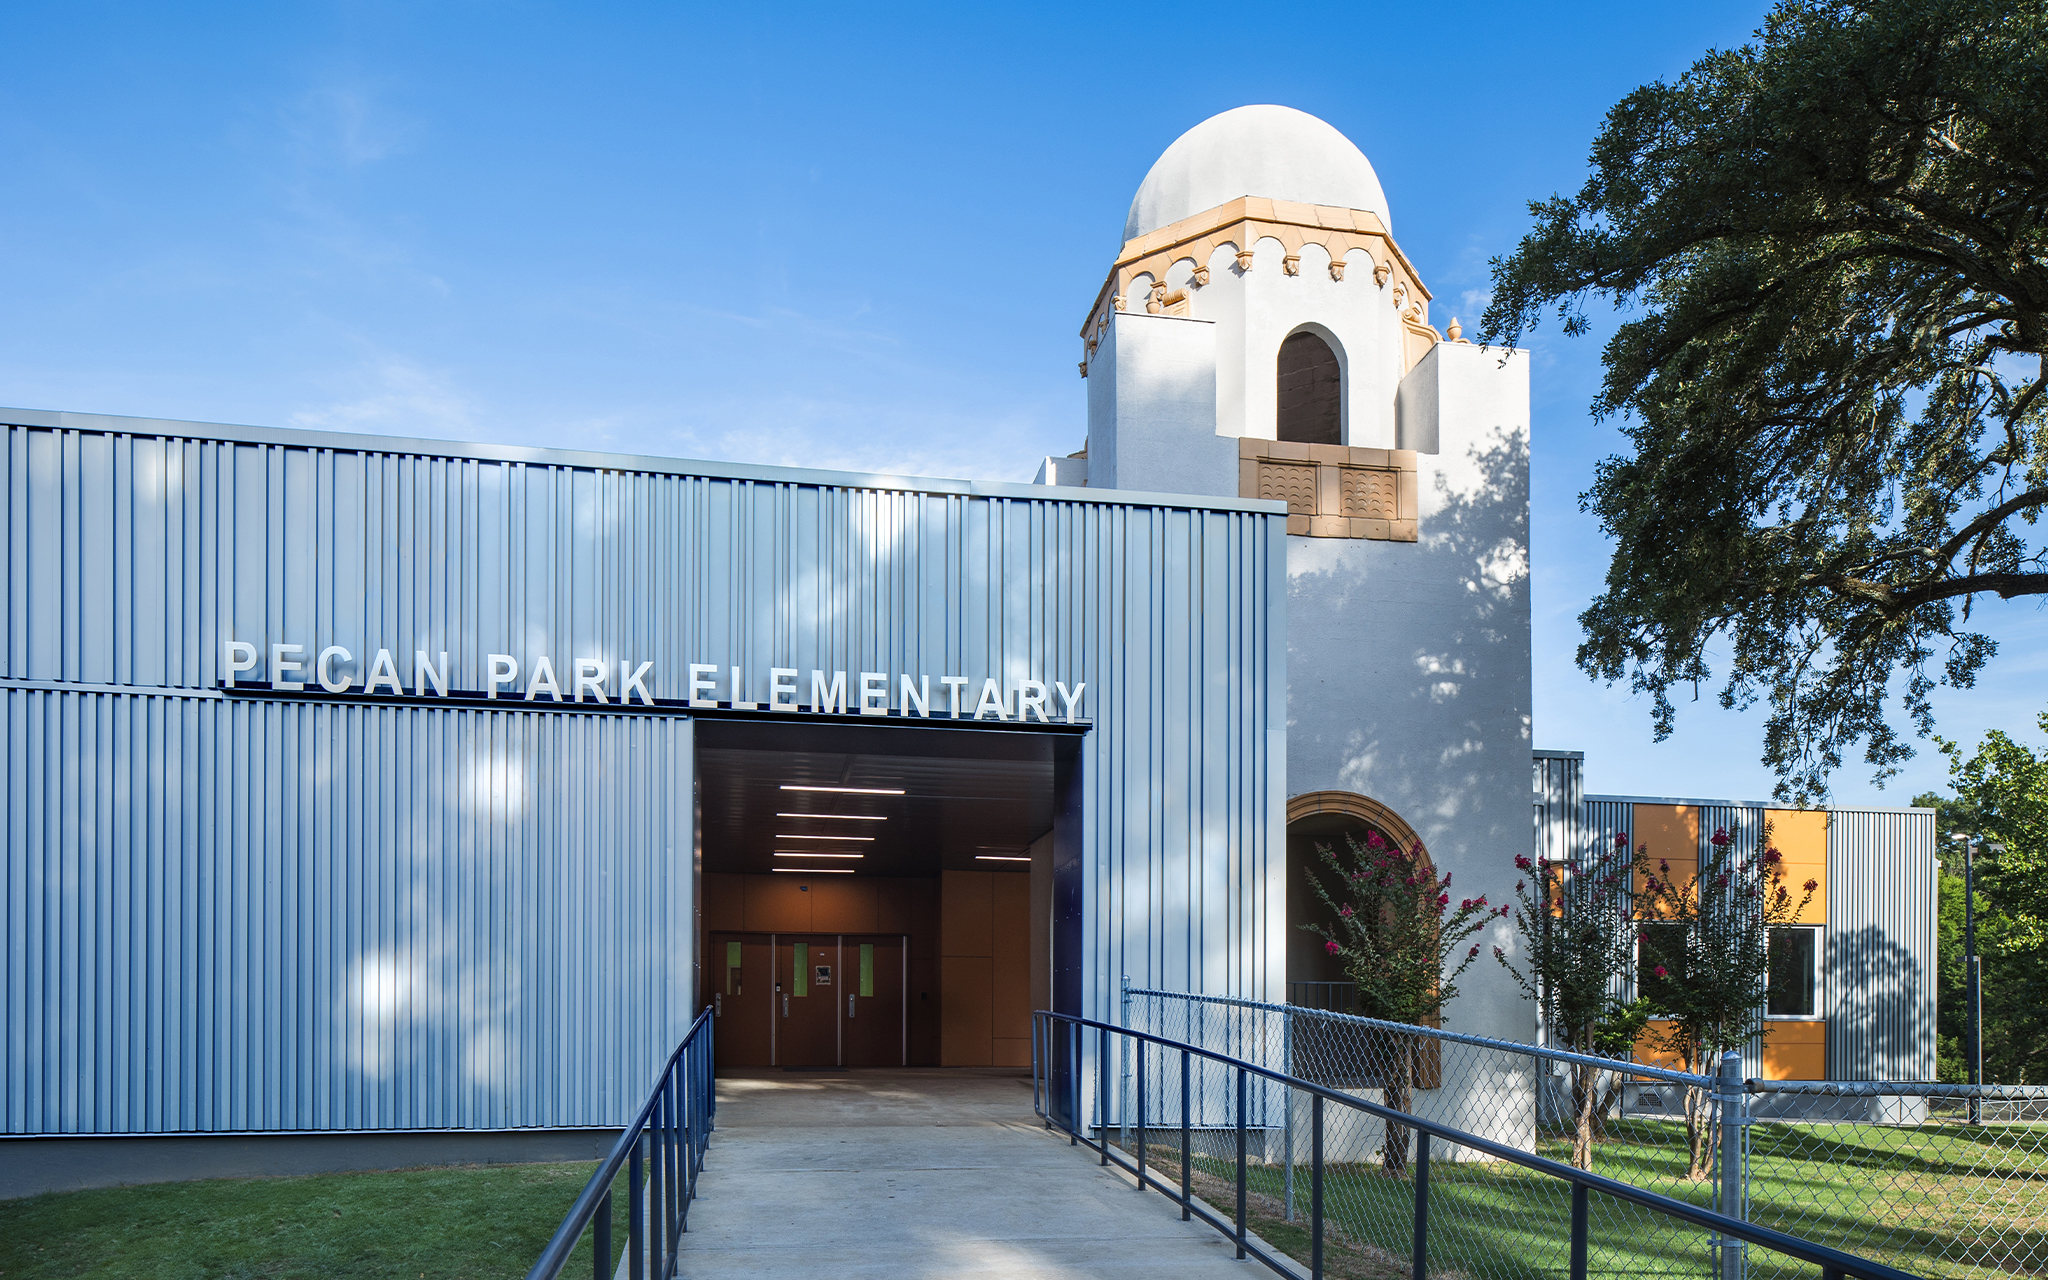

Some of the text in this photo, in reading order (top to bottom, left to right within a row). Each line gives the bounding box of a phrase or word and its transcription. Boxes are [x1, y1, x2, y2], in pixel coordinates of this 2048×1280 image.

[224, 641, 1087, 724] PECAN PARK ELEMENTARY
